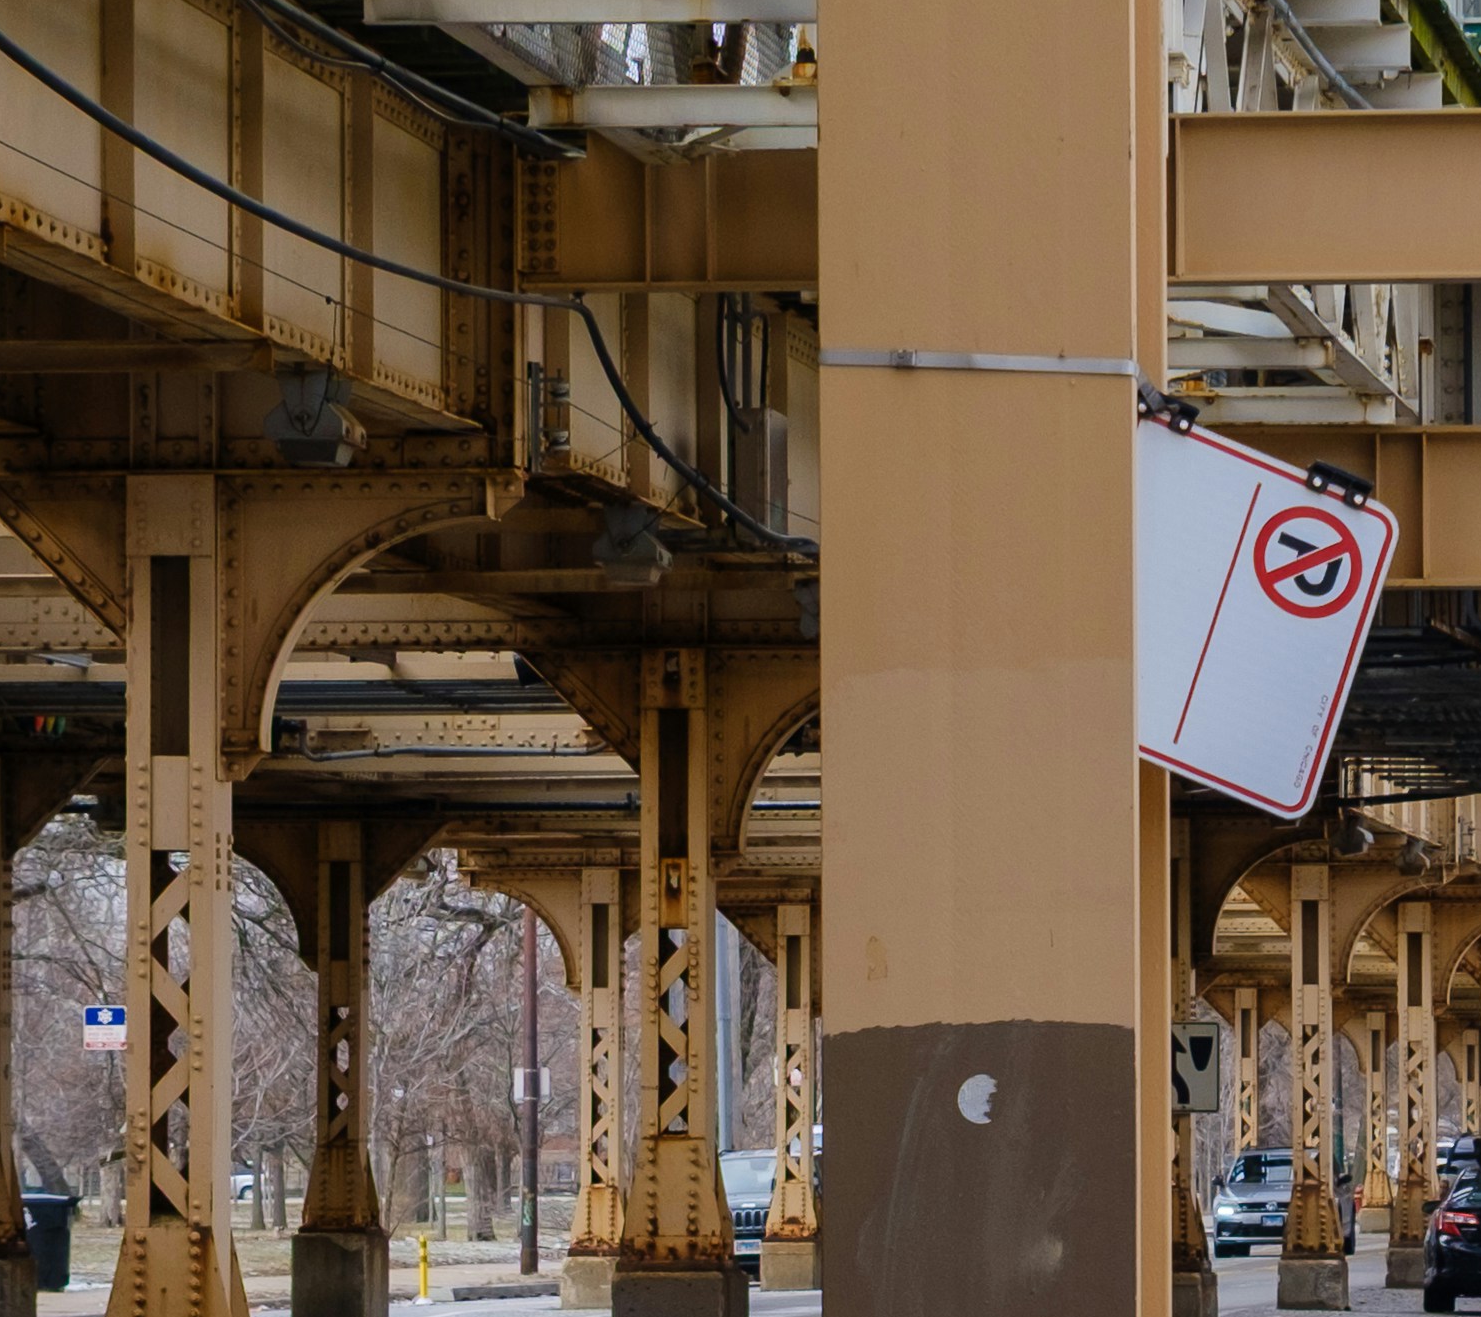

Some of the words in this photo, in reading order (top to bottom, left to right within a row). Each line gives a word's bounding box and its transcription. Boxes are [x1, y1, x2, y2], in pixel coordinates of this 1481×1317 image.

[1317, 694, 1329, 718] CITY
[1311, 724, 1320, 738] OF
[1293, 744, 1313, 789] CHICAGO
